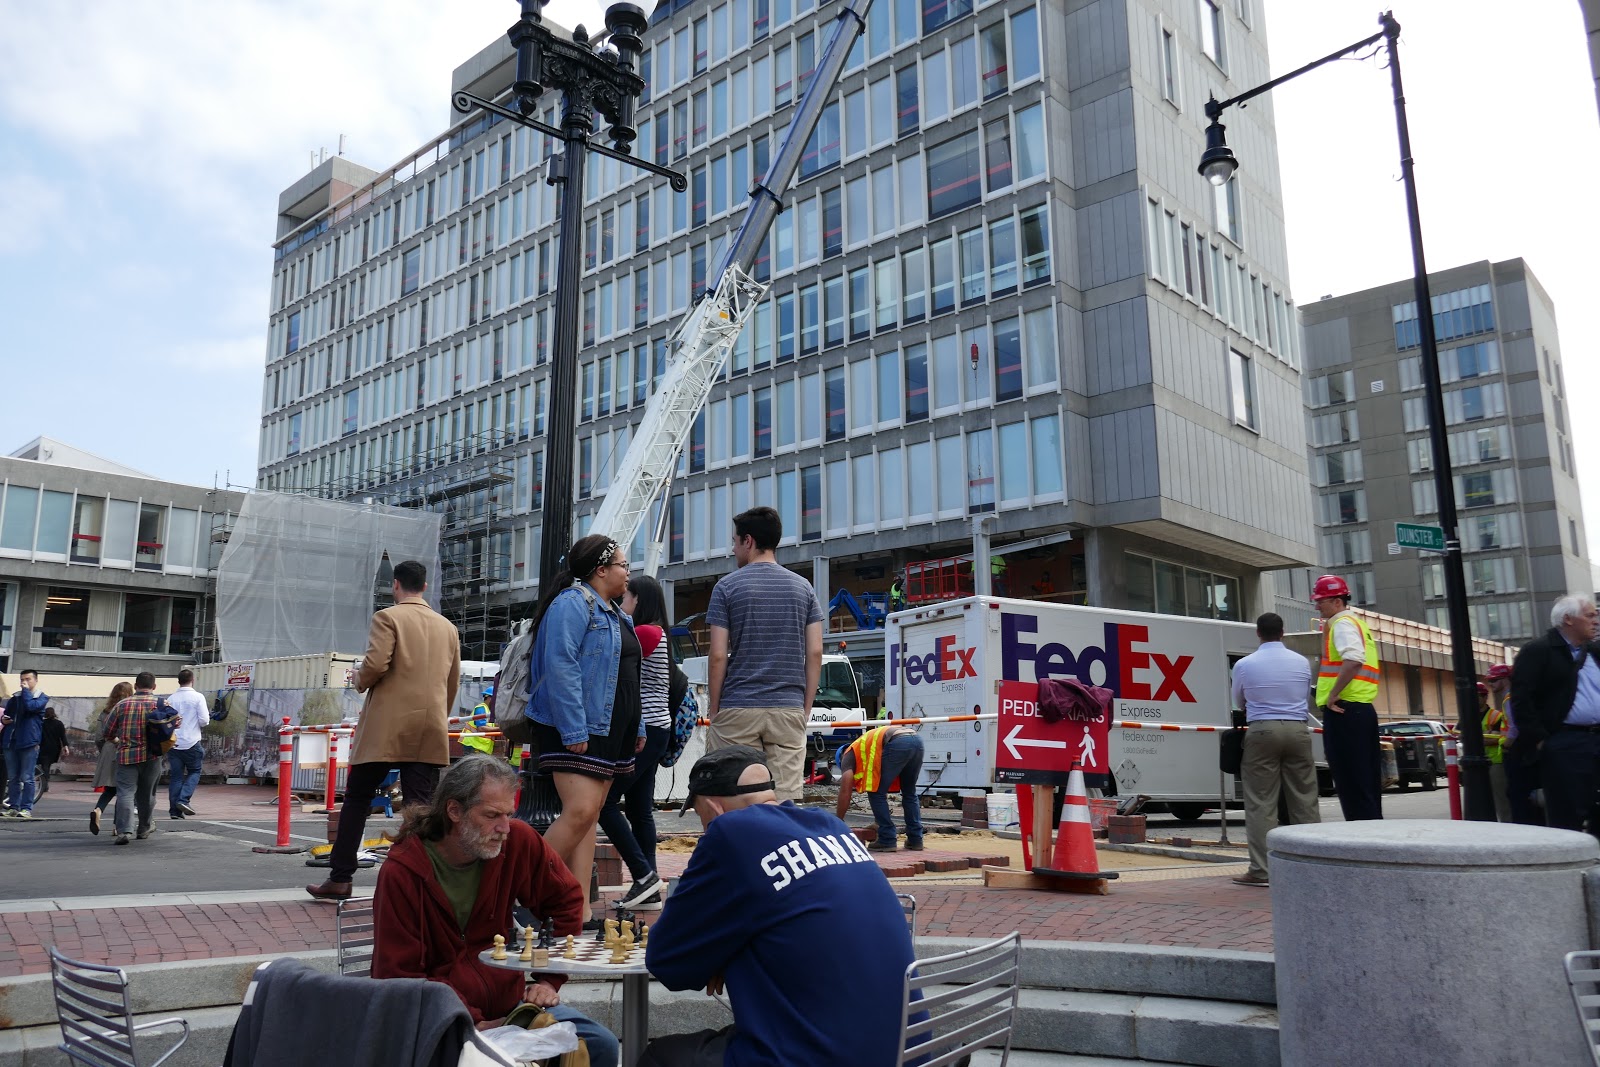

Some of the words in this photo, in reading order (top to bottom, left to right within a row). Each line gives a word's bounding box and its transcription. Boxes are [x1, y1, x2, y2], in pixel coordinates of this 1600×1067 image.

[1398, 527, 1433, 545] DUNSTER
[890, 634, 978, 686] FedEx
[1001, 612, 1197, 703] FedEx
[942, 682, 966, 693] Express
[811, 713, 837, 722] AmQuip
[1002, 698, 1105, 724] PEDERIAS
[1120, 703, 1162, 720] Express
[1122, 730, 1164, 742] fedex.com
